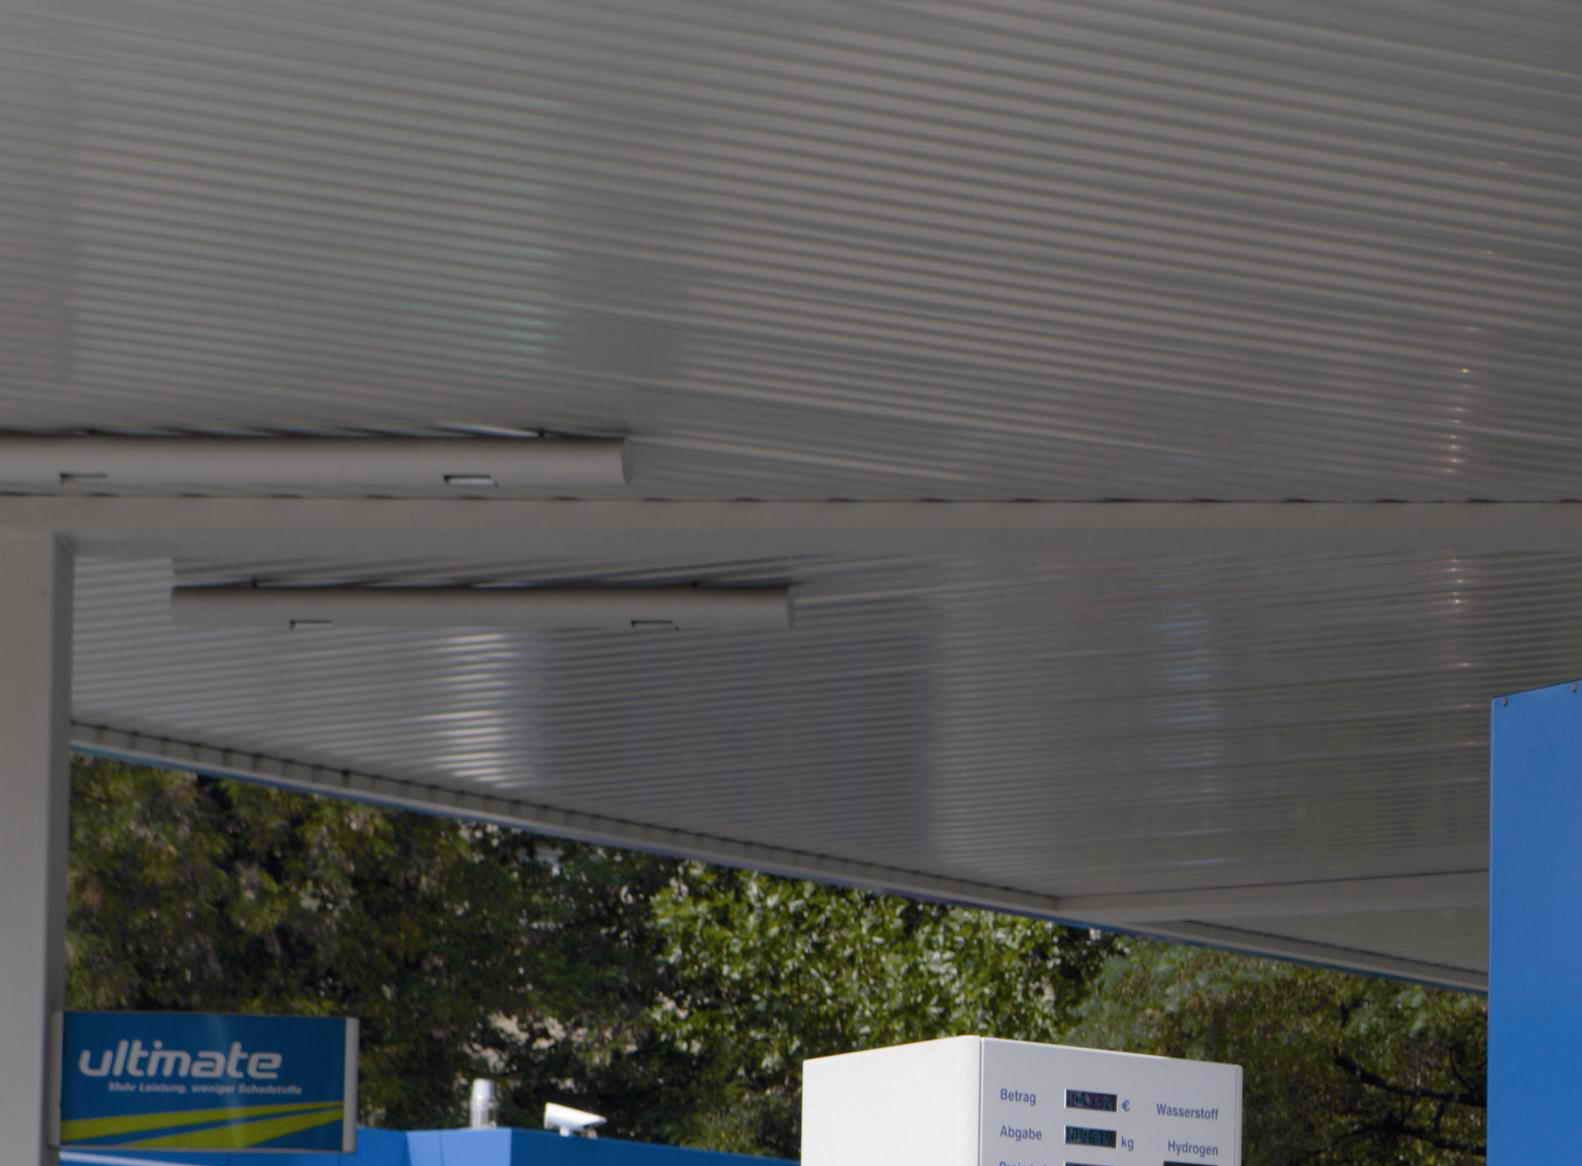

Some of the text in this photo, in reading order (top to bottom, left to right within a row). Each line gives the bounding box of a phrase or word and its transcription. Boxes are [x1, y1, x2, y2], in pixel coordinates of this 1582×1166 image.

[78, 1040, 283, 1078] ultimate
[1000, 1088, 1130, 1112] Betrag €
[1156, 1103, 1219, 1121] Wasserstoff
[1000, 1124, 1134, 1152] Abgabe kg
[1168, 1139, 1219, 1158] Hydrogen
